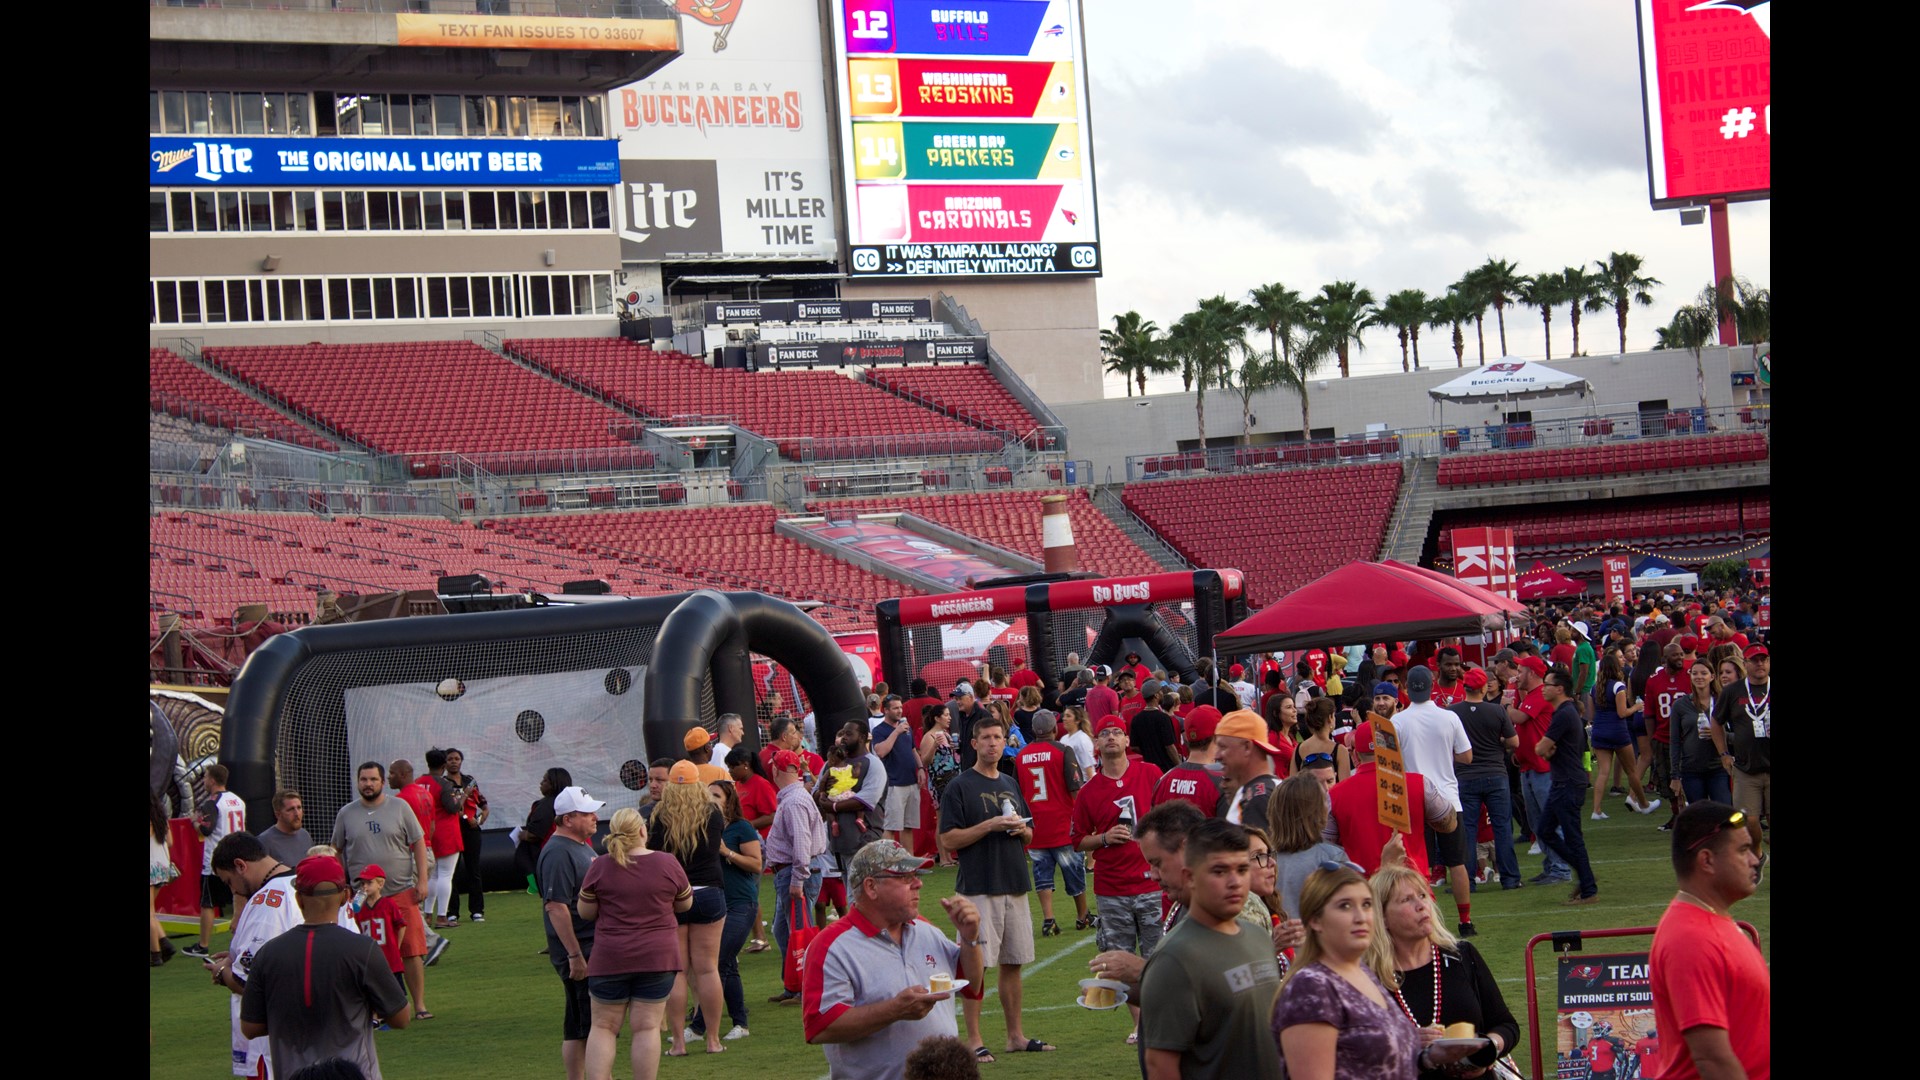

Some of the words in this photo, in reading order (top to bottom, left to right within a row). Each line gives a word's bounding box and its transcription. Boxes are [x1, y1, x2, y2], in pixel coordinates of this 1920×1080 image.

[852, 10, 888, 39] 12
[931, 10, 989, 24] BUFFALO
[439, 23, 478, 37] TEXT
[484, 25, 514, 38] FAN
[520, 25, 575, 39] ISSUES
[580, 27, 600, 39] TO
[604, 28, 645, 40] 33607
[935, 24, 989, 41] BILLS
[648, 81, 720, 91] TAMPA
[734, 82, 773, 92] BAY
[857, 73, 893, 103] 13
[922, 72, 1008, 87] WASHINGTON
[918, 86, 1014, 105] REDSKINS
[620, 89, 804, 136] BUCCANEERS
[933, 135, 977, 148] GREEN
[979, 135, 1006, 148] BAY
[860, 136, 898, 166] 14
[927, 149, 1014, 167] PACKERS
[151, 148, 195, 172] Miller
[193, 142, 253, 182] Lite
[277, 150, 309, 166] THE
[313, 151, 416, 172] ORIGINAL
[421, 151, 483, 172] LIGHT
[488, 151, 543, 172] BEER
[764, 171, 804, 192] IT'S
[746, 198, 826, 219] MILLER
[945, 196, 1002, 210] ARIZONA
[616, 181, 698, 243] Lite
[918, 210, 1032, 230] CARDINALS
[761, 225, 814, 245] TIME
[856, 252, 877, 267] CC
[886, 245, 898, 259] IT
[900, 245, 932, 259] WAS
[933, 244, 978, 258] TAMPA
[979, 244, 1005, 258] ALL
[1005, 243, 1058, 258] ALONG?
[1074, 249, 1094, 264] CC
[906, 259, 982, 274] DEFINITELY
[981, 258, 1044, 273] WITHOUT
[1045, 258, 1055, 272] A
[725, 309, 740, 317] FAN
[741, 308, 761, 316] DECK
[807, 306, 821, 314] FAN
[822, 306, 841, 314] DECK
[895, 305, 914, 313] DECK
[779, 350, 796, 359] FAN
[796, 350, 818, 359] DECK
[936, 346, 952, 354] FAN
[953, 345, 974, 354] DECK
[1605, 559, 1627, 572] Lite
[1112, 581, 1150, 603] BUCS
[930, 598, 994, 618] BUCCANEERS
[1022, 751, 1051, 765] WINSTON
[1029, 766, 1049, 803] 3
[1169, 778, 1198, 796] EVANS
[227, 810, 245, 833] 13
[366, 820, 381, 835] TB
[1564, 993, 1615, 1004] ENTRANCE
[1616, 992, 1629, 1002] AT
